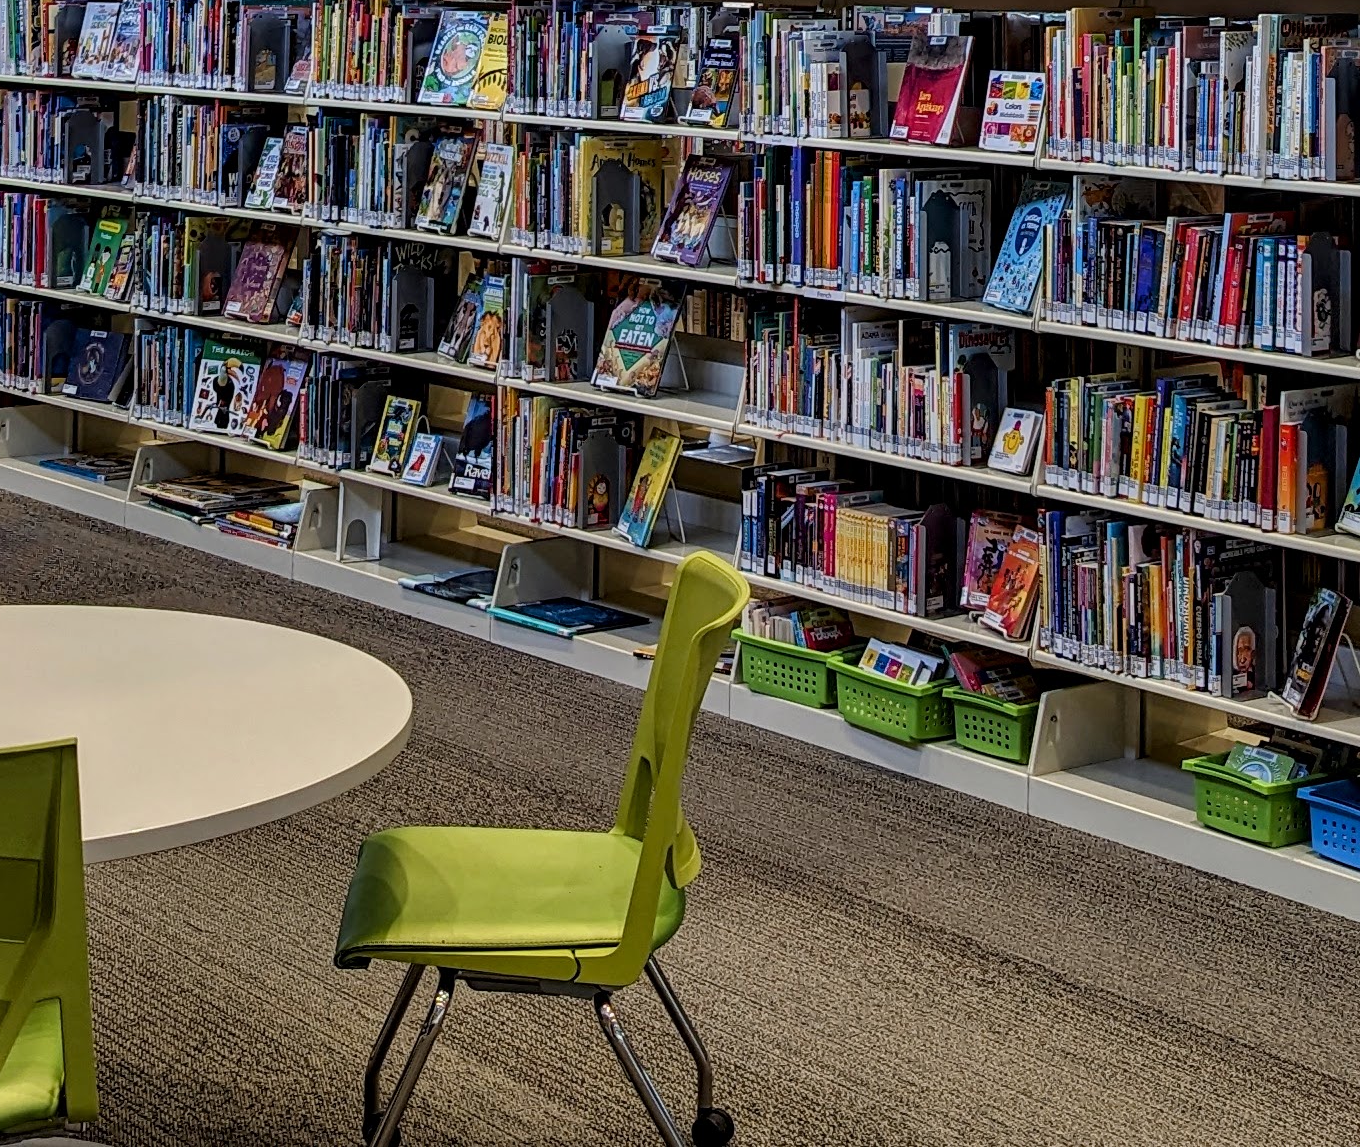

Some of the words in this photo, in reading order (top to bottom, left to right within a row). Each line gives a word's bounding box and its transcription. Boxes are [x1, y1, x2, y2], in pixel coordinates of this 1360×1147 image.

[1004, 102, 1022, 111] Colors
[687, 167, 722, 184] Horses
[395, 242, 425, 263] WILD
[629, 313, 644, 324] NOT
[644, 315, 656, 326] TO
[618, 328, 656, 348] EATEN
[1195, 605, 1203, 639] CUERPO
